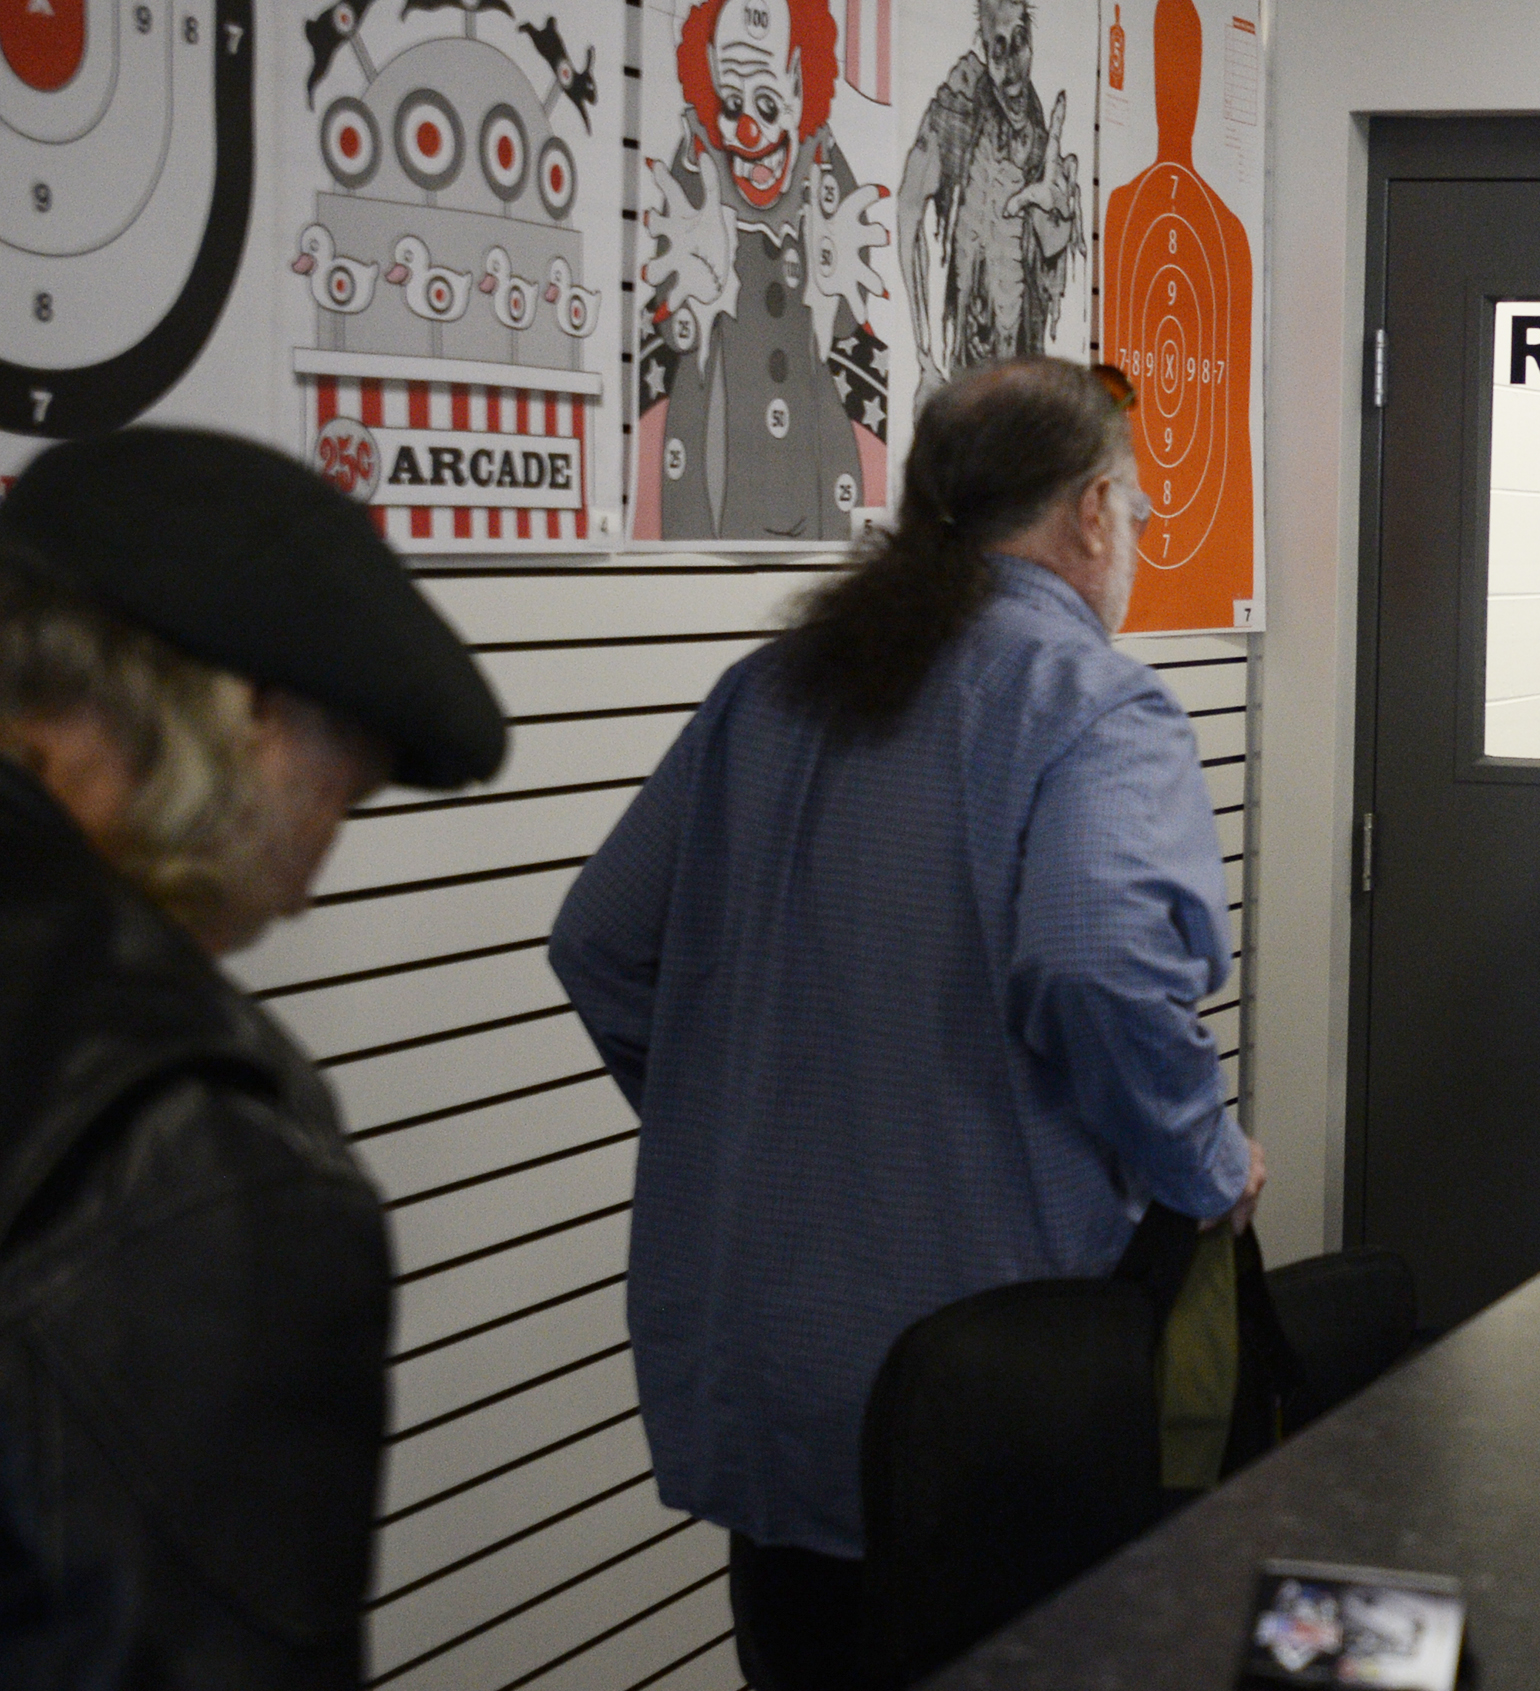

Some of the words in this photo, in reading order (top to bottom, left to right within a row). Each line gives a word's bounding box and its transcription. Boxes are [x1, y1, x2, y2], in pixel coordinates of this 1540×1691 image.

[135, 5, 152, 35] 9
[183, 15, 199, 45] 8
[226, 22, 243, 54] 7
[744, 7, 768, 29] 100
[33, 182, 52, 213] 9
[1170, 175, 1179, 199] 7
[1168, 229, 1178, 254] 8
[1167, 280, 1177, 306] 9
[34, 292, 53, 322] 8
[678, 320, 690, 338] 25
[1165, 354, 1175, 380] X
[31, 390, 53, 423] 7
[773, 409, 785, 427] 50
[1164, 427, 1173, 452] 9
[388, 446, 572, 489] ARCADE
[669, 450, 681, 468] 25
[840, 484, 852, 502] 25
[1163, 480, 1171, 505] 8
[1162, 534, 1170, 558] 7
[1244, 608, 1252, 622] 7
